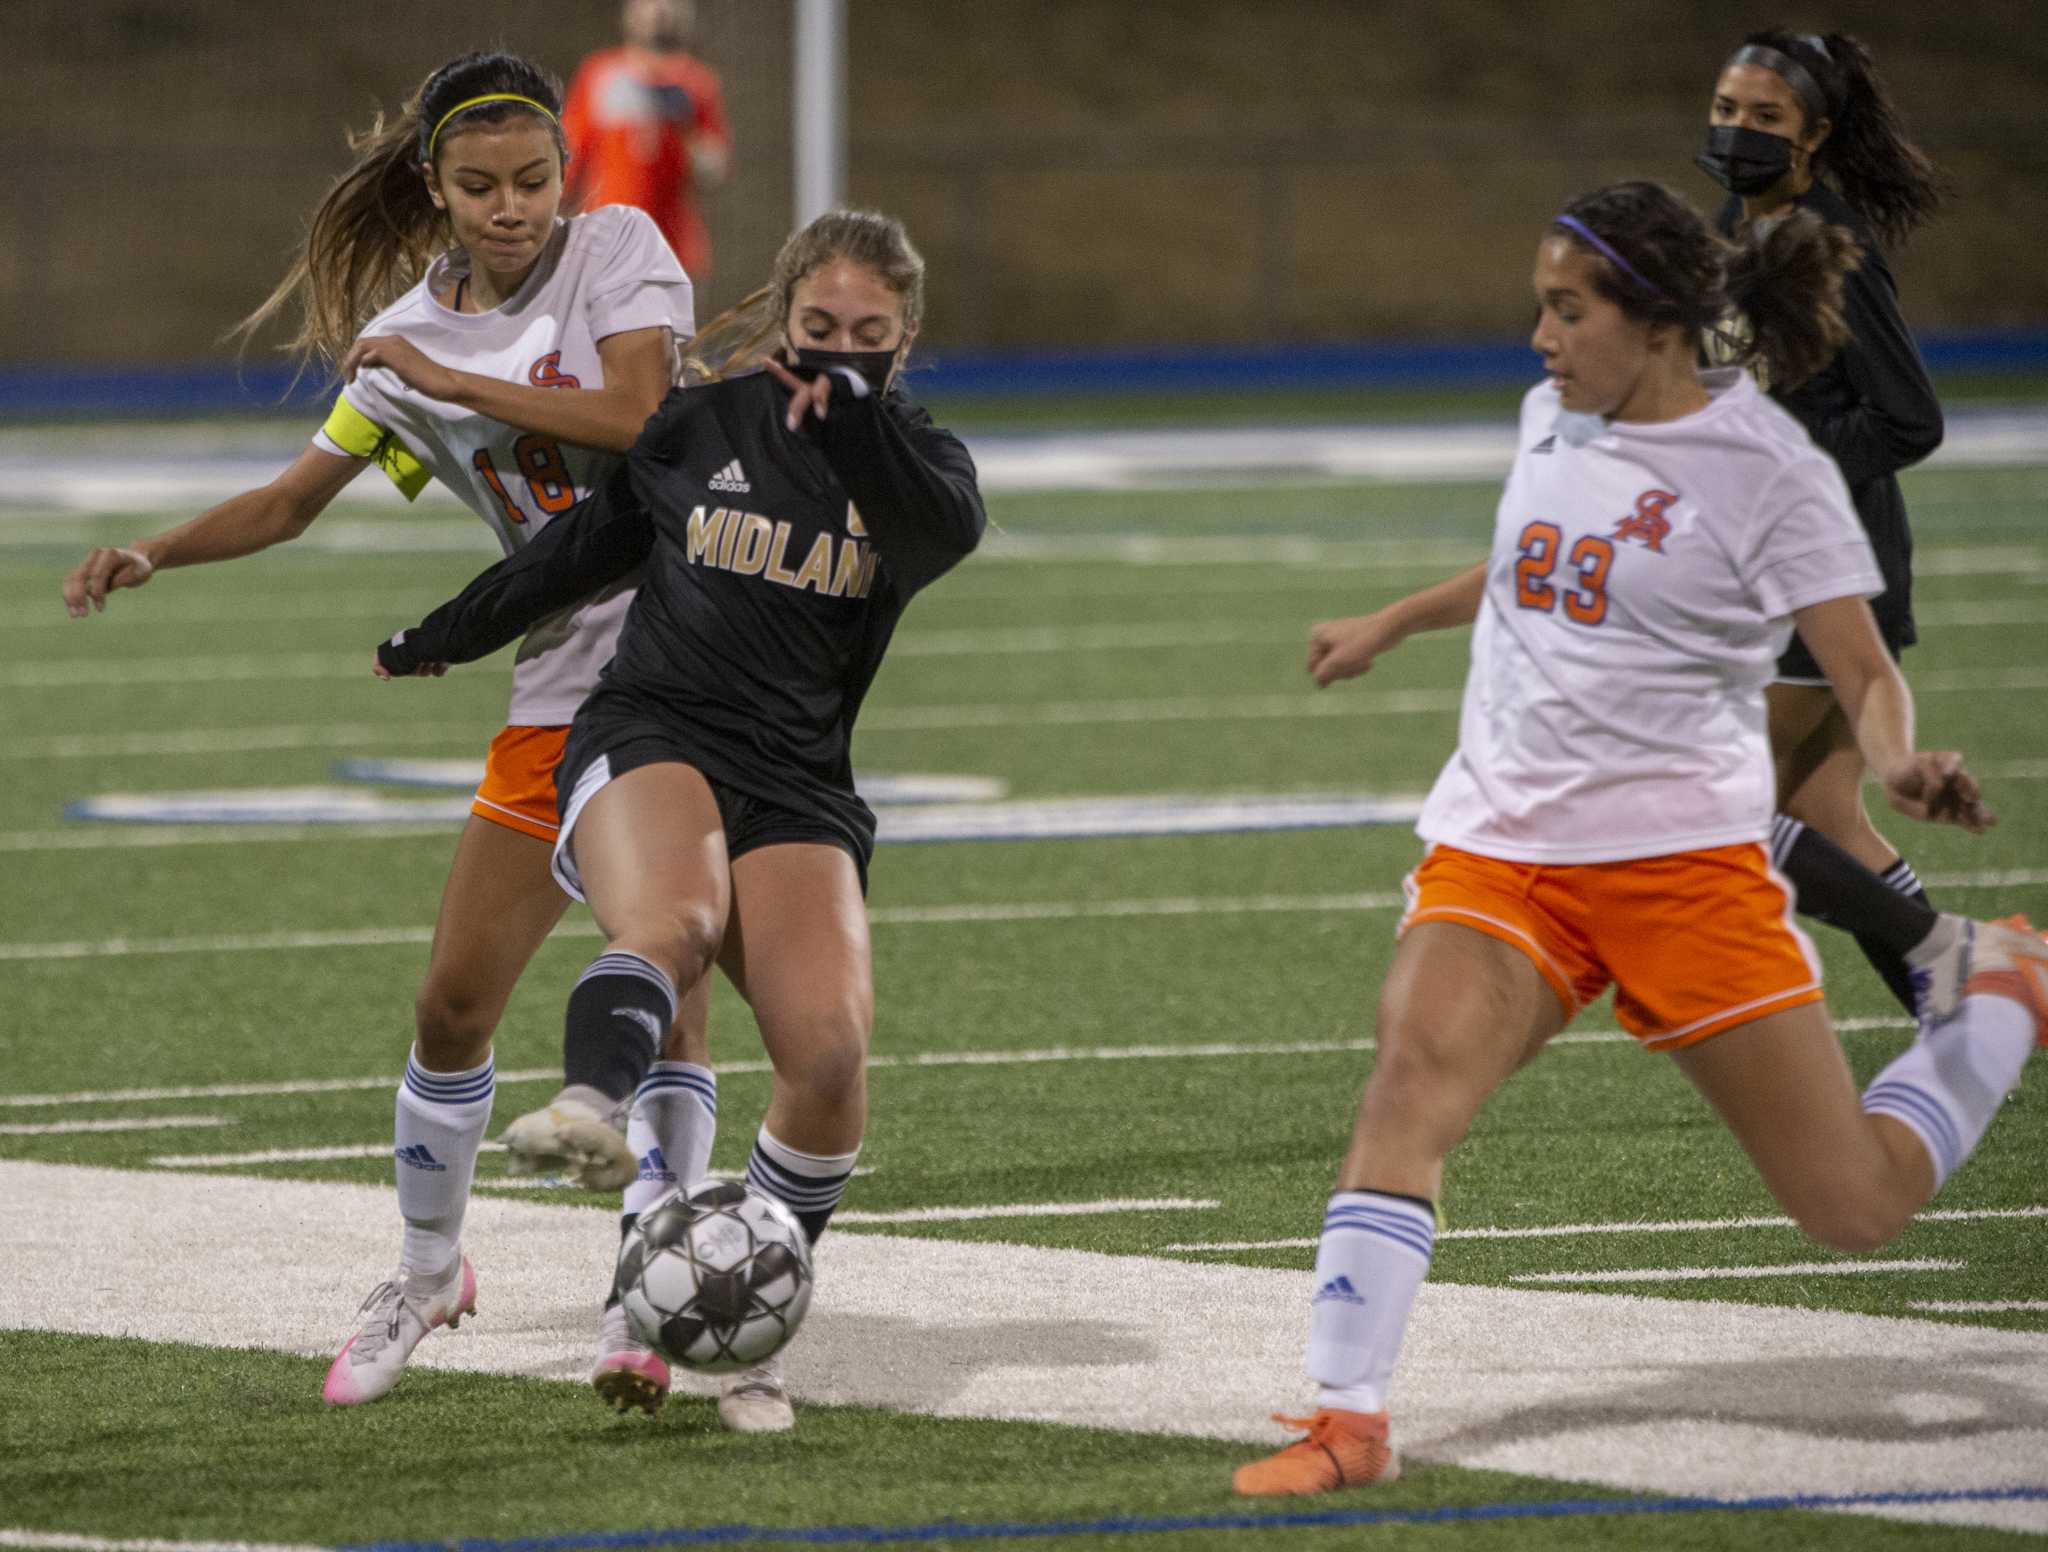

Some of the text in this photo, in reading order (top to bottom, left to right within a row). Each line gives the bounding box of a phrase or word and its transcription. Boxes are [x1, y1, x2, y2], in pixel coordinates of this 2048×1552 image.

[473, 435, 576, 524] 18
[708, 480, 751, 493] adidas
[687, 505, 878, 598] MIDLAN
[1515, 521, 1615, 627] 23
